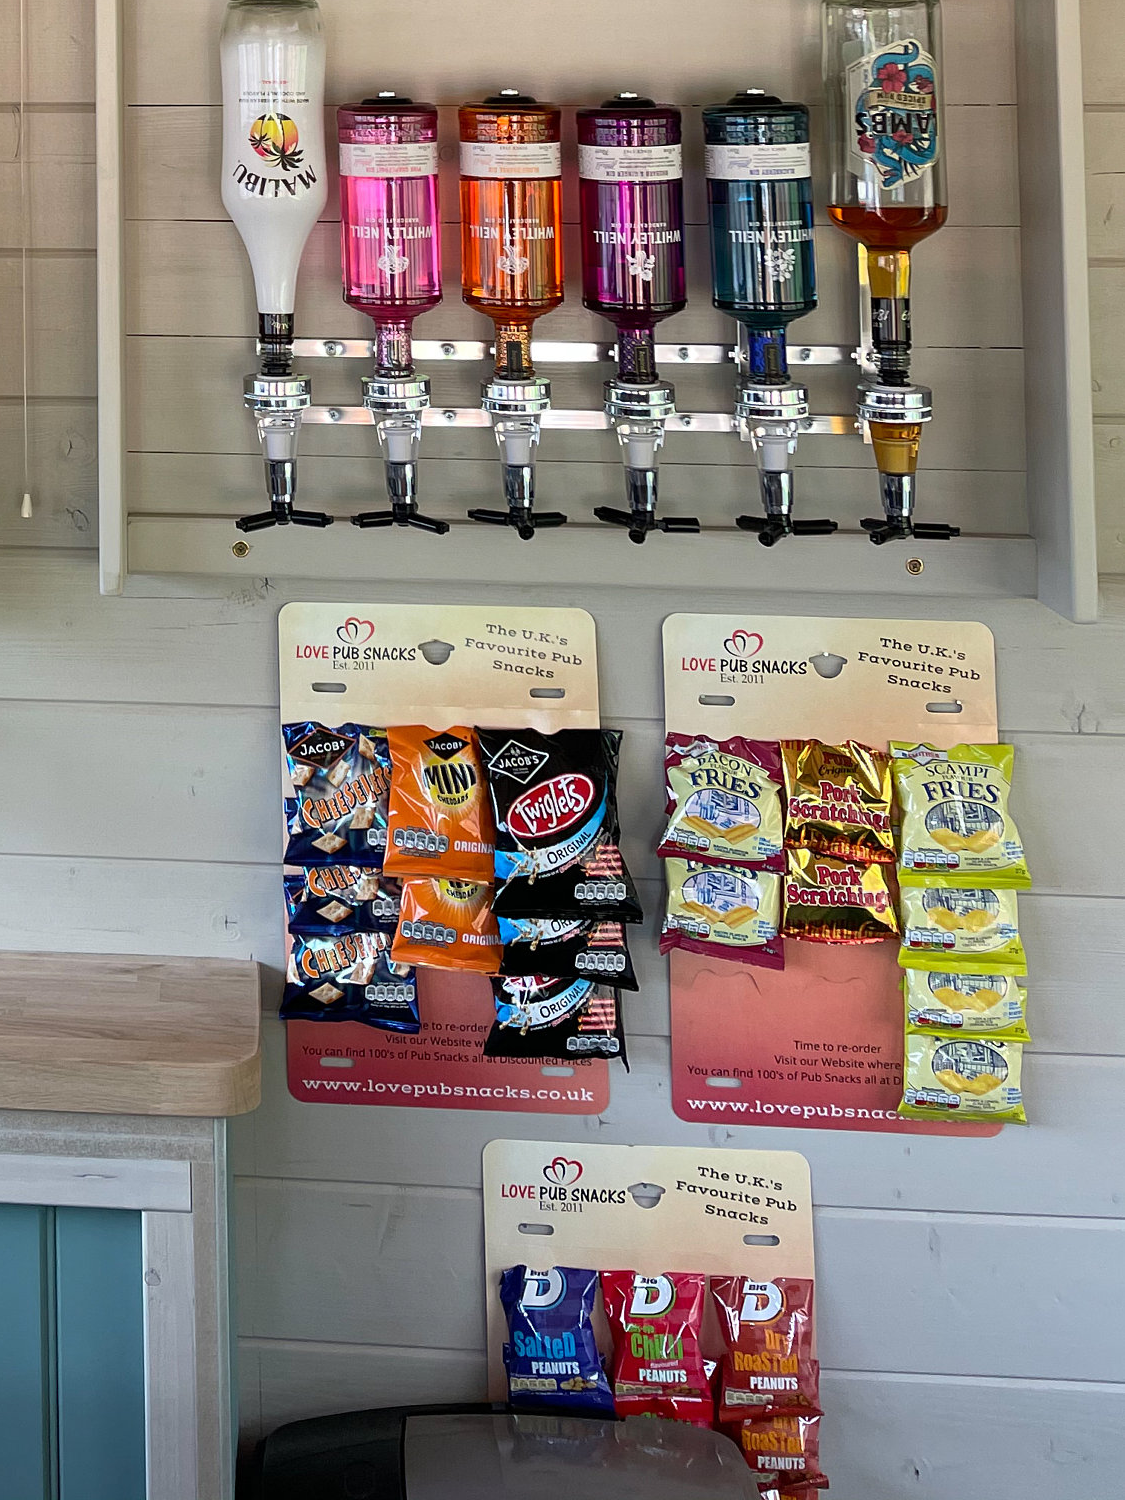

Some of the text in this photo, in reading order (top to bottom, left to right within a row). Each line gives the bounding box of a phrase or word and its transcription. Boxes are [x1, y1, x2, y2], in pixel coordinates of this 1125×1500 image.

[896, 94, 926, 104] SPICED
[233, 163, 317, 197] MALIBU
[350, 225, 432, 239] WHITLEY NEILL
[470, 225, 554, 240] WHITLEY NEILL
[593, 230, 681, 244] WHITLEY NEILL
[728, 229, 813, 244] WHITLEY NEILL
[486, 623, 517, 638] The
[465, 637, 583, 666] Favourite Pub
[879, 637, 913, 652] The
[296, 645, 416, 661] LOVE PUB SNACKS
[332, 660, 375, 671] Est. 2011
[492, 660, 555, 679] Snacks
[681, 657, 807, 674] LOVE PUB SNACKS
[858, 651, 981, 681] Favourite Pub
[720, 673, 765, 684] Est. 2011
[887, 674, 952, 694] Snacks
[499, 755, 540, 768] JACOB'S
[697, 753, 753, 776] BACON
[424, 762, 477, 794] MINI
[925, 764, 989, 778] SCAMPI
[688, 768, 763, 799] FRIES
[302, 767, 392, 829] CHEESELETS
[437, 794, 469, 805] CHEDDARS
[819, 780, 862, 805] Pork
[922, 781, 1000, 804] FRIES
[547, 831, 592, 864] ORIGINAL
[816, 865, 862, 886] Pork
[539, 984, 585, 1019] ORIGINAL
[432, 1022, 443, 1031] to
[445, 1022, 488, 1033] re-order
[386, 1034, 407, 1045] Visit
[410, 1038, 427, 1046] our
[430, 1036, 472, 1048] Website
[793, 1040, 882, 1054] Time to re-order
[302, 1046, 322, 1058] You
[325, 1049, 342, 1058] can
[345, 1047, 366, 1059] find
[369, 1049, 394, 1060] 100's
[397, 1050, 409, 1061] of
[411, 1051, 431, 1062] Pub
[434, 1052, 469, 1064] Snacks
[472, 1053, 484, 1064] all
[774, 1055, 902, 1070] Visit our Website where
[687, 1065, 708, 1077] You
[711, 1068, 730, 1077] can
[733, 1067, 754, 1079] find
[757, 1069, 784, 1081] 100's
[787, 1070, 799, 1082] of
[801, 1071, 822, 1083] Pub
[825, 1073, 862, 1085] Snacks
[865, 1074, 877, 1085] all
[880, 1076, 891, 1086] at
[302, 1079, 594, 1102] www.lovepubsnacks.co.uk
[697, 1166, 730, 1182] The
[501, 1184, 626, 1204] LOVE PUB SNACKS
[675, 1180, 797, 1212] Favourite Pub
[539, 1201, 584, 1213] Est. 2011
[705, 1204, 769, 1225] Snacks
[531, 1361, 580, 1375] PEANUTS
[638, 1368, 687, 1383] PEANUTS
[750, 1376, 798, 1390] PEANUTS
[757, 1455, 806, 1470] PEANUTS
